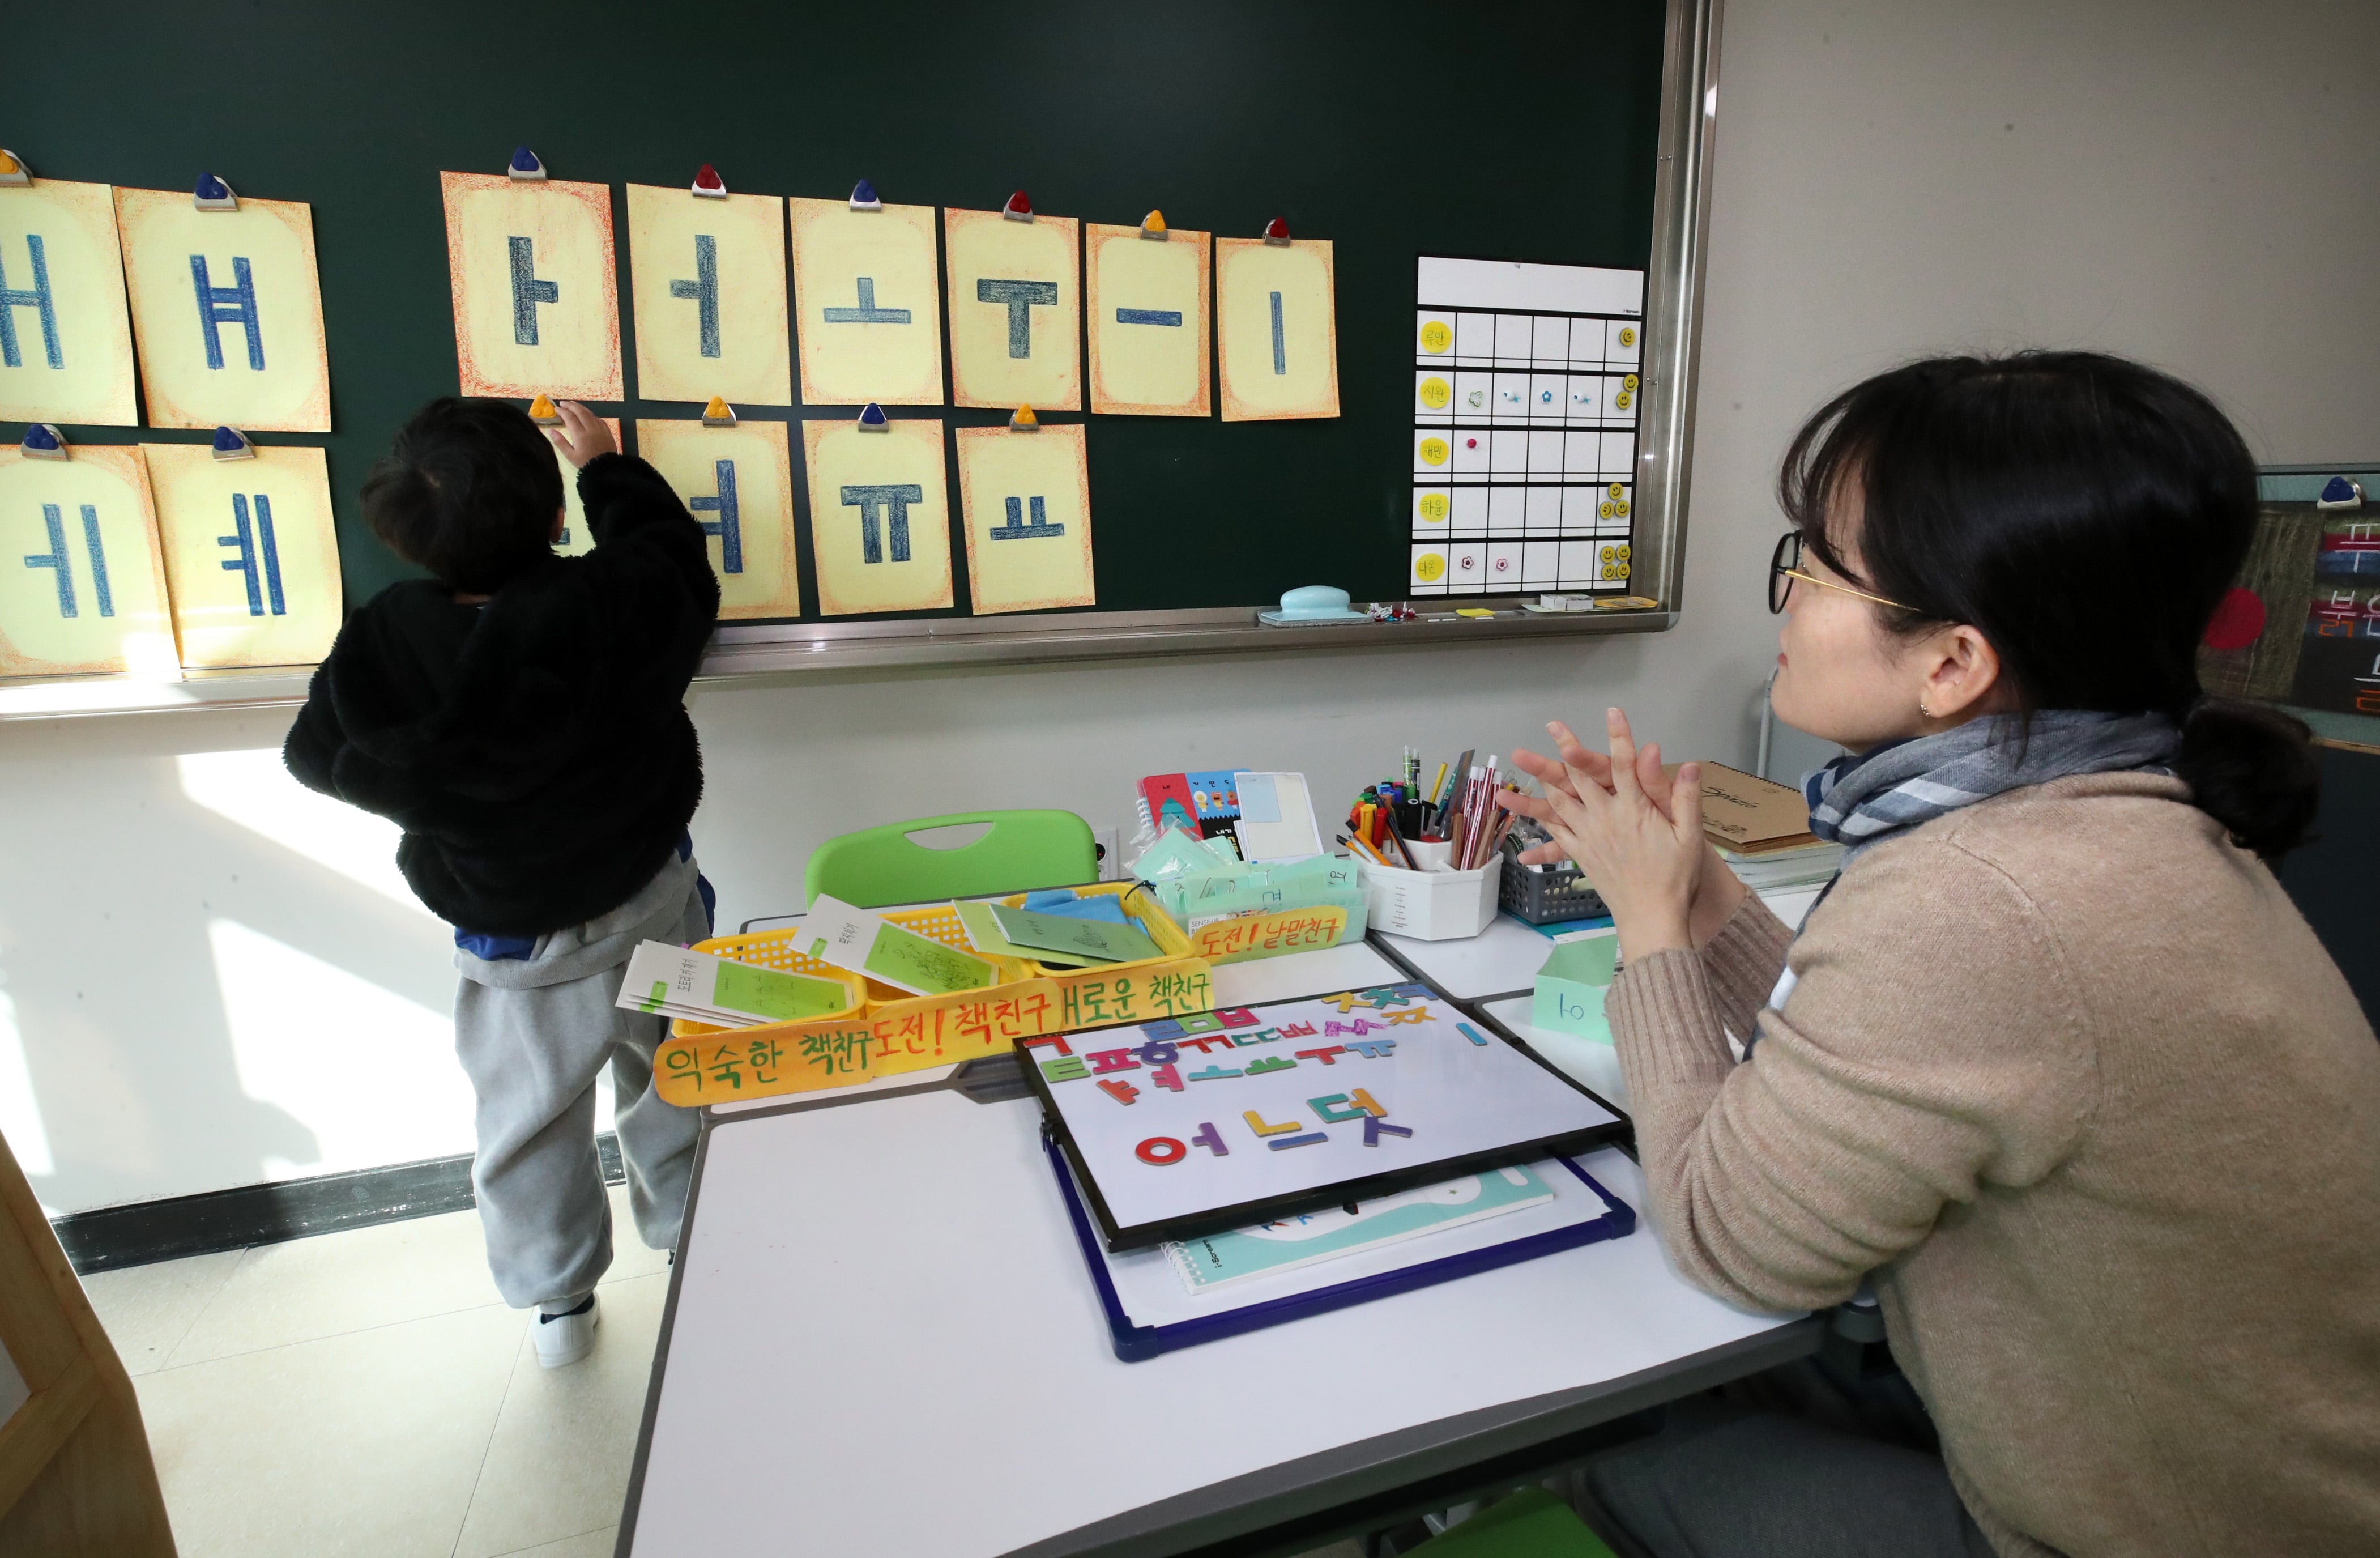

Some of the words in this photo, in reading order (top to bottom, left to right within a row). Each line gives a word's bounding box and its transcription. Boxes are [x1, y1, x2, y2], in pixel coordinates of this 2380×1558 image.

[508, 236, 558, 345] ㅏ
[670, 235, 721, 358] ㅓ
[824, 277, 912, 323] ㅗ
[977, 278, 1057, 359] ㅜ
[1425, 330, 1445, 346] 루안
[1423, 385, 1445, 403] 시완
[1422, 444, 1441, 458] 재민
[840, 484, 923, 564] ㅠ
[989, 496, 1064, 541] ㅛ
[1421, 499, 1443, 516] 하윤
[24, 503, 115, 618] ㅔ
[217, 493, 287, 616] ㅖ
[1418, 560, 1435, 576] 다온
[1200, 922, 1259, 958] 도전!
[1264, 917, 1340, 950] 낱말친구
[1149, 973, 1211, 1016] 책친구
[873, 1009, 945, 1058] 도전!
[954, 993, 1052, 1045] 책친구
[666, 1038, 784, 1092] 익숙한
[799, 1030, 875, 1075] 책친구
[1202, 1239, 1222, 1269] i-Scream
